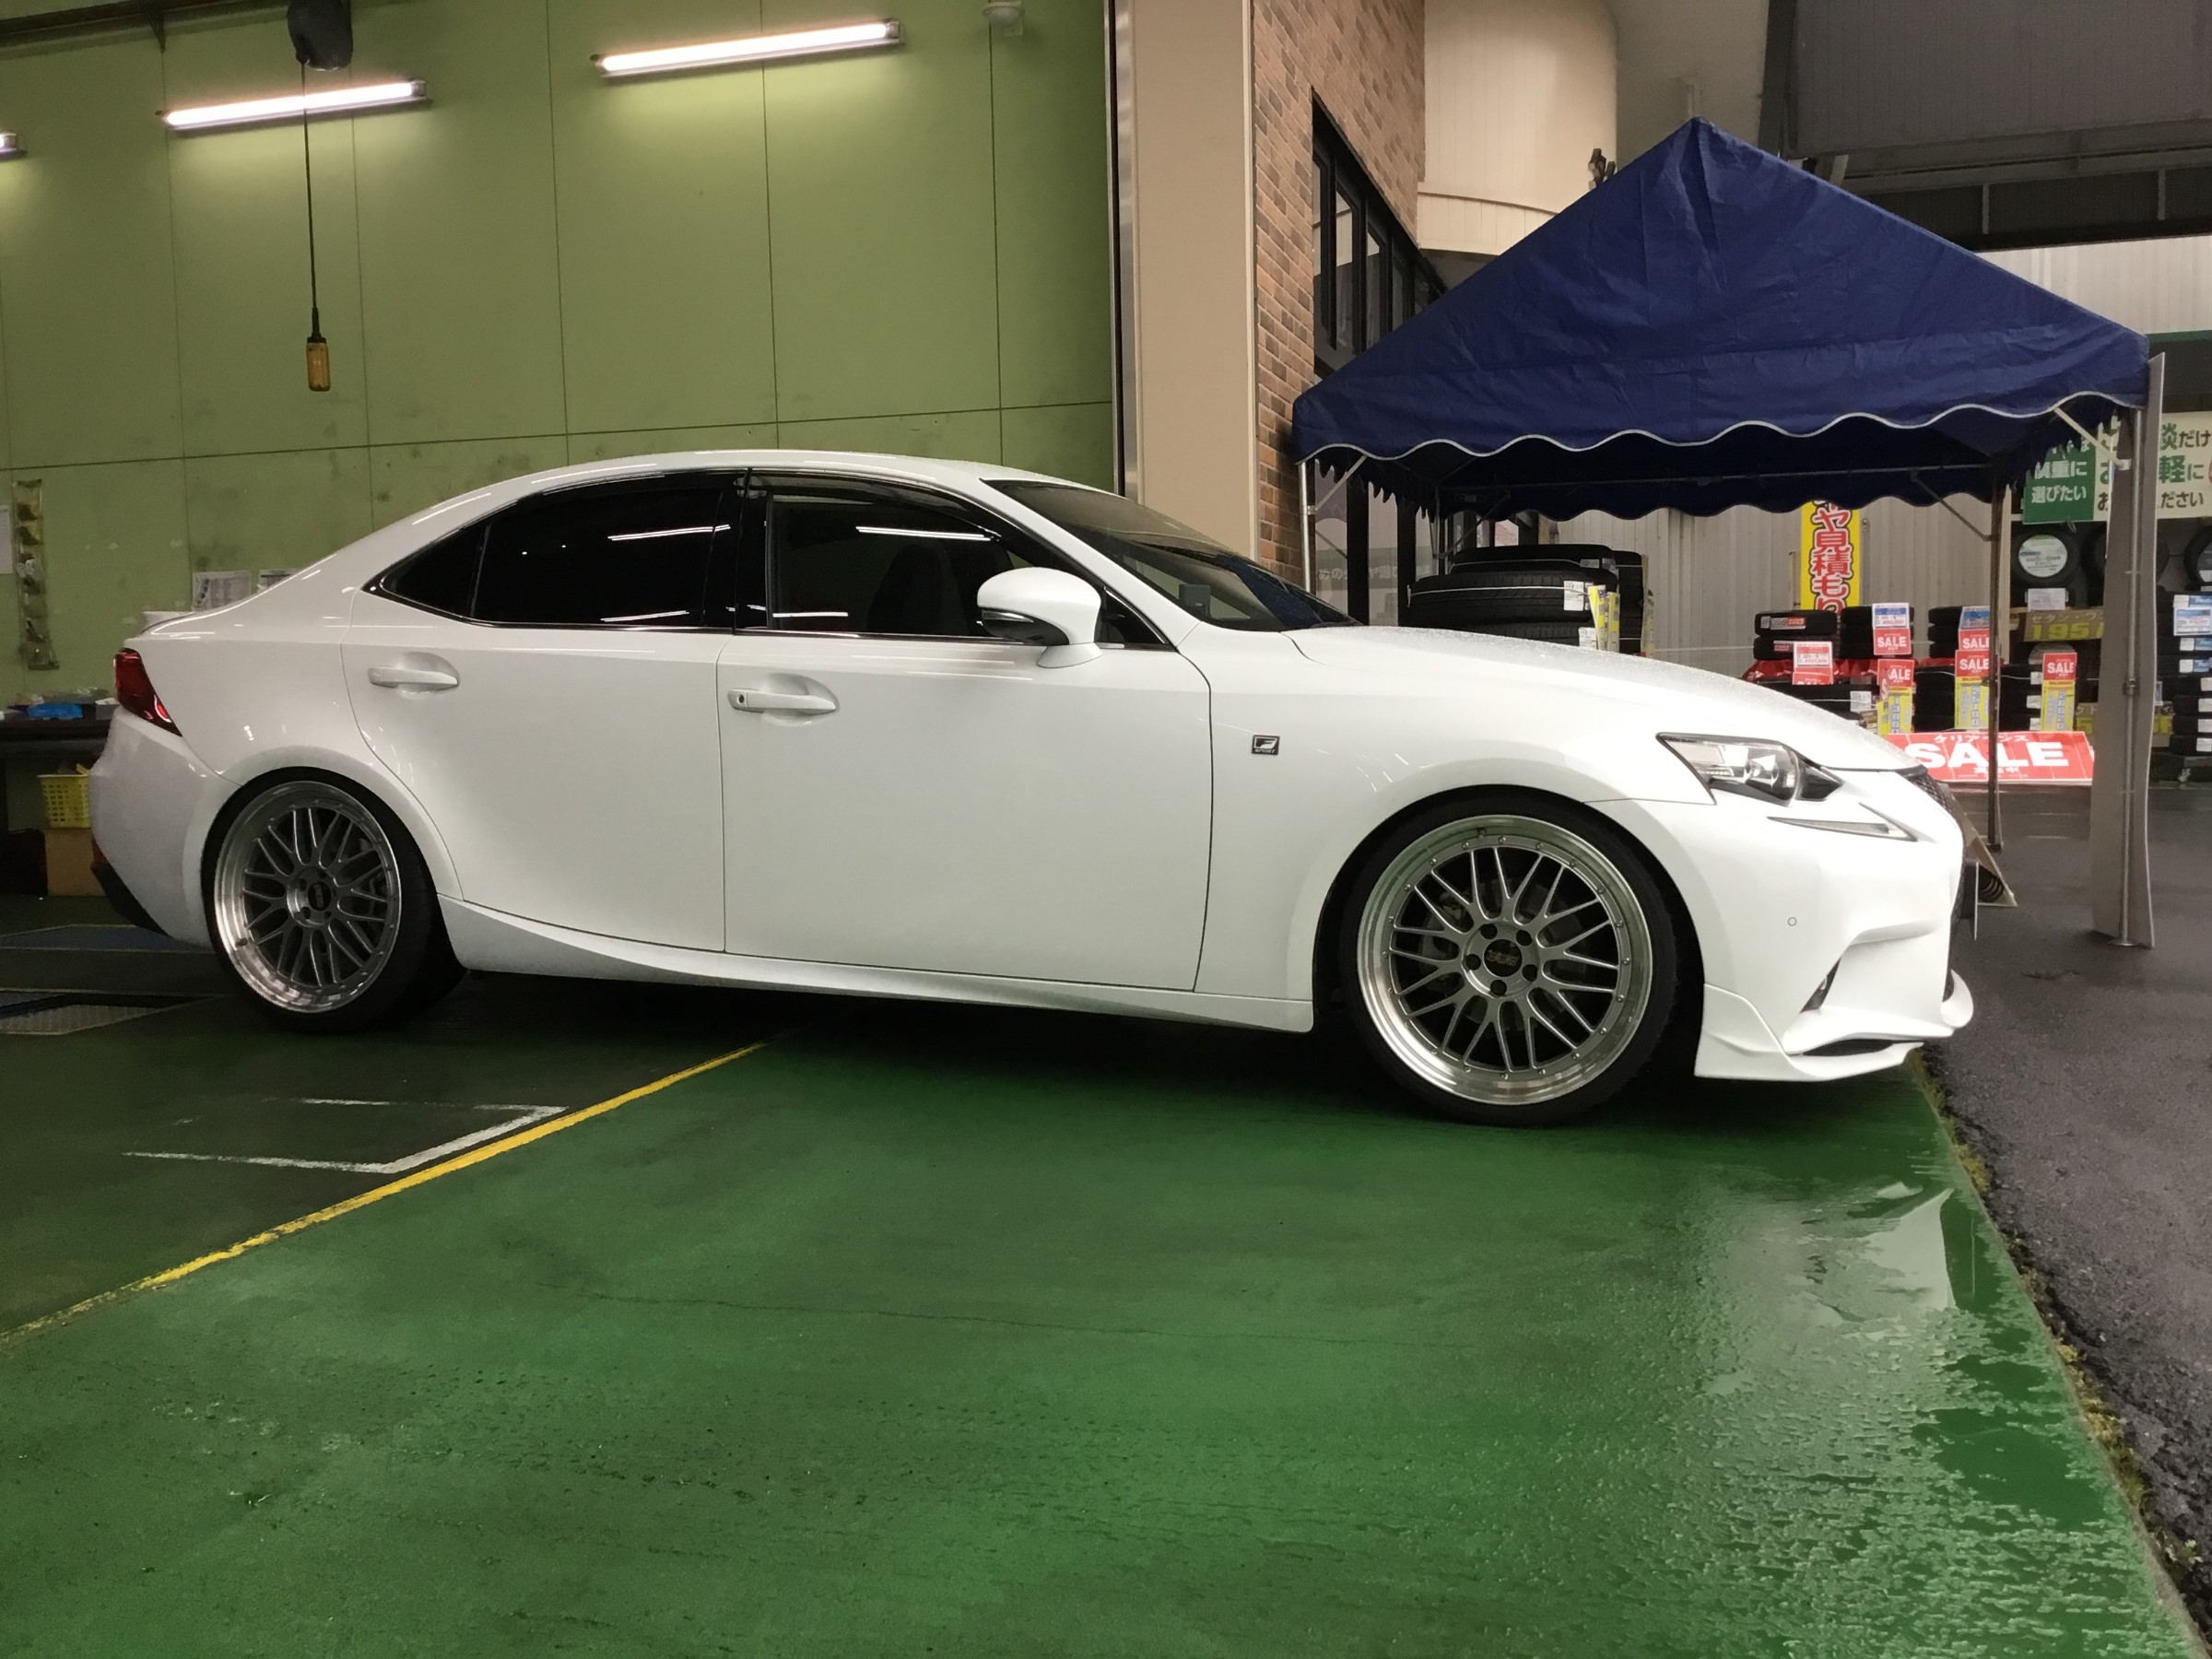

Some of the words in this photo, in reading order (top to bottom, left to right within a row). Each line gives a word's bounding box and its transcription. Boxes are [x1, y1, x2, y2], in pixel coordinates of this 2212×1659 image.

[2031, 485, 2087, 503] 選びたい
[1877, 636, 1907, 648] SALE
[2047, 663, 2075, 674] SALE
[1904, 742, 2070, 769] SALE
